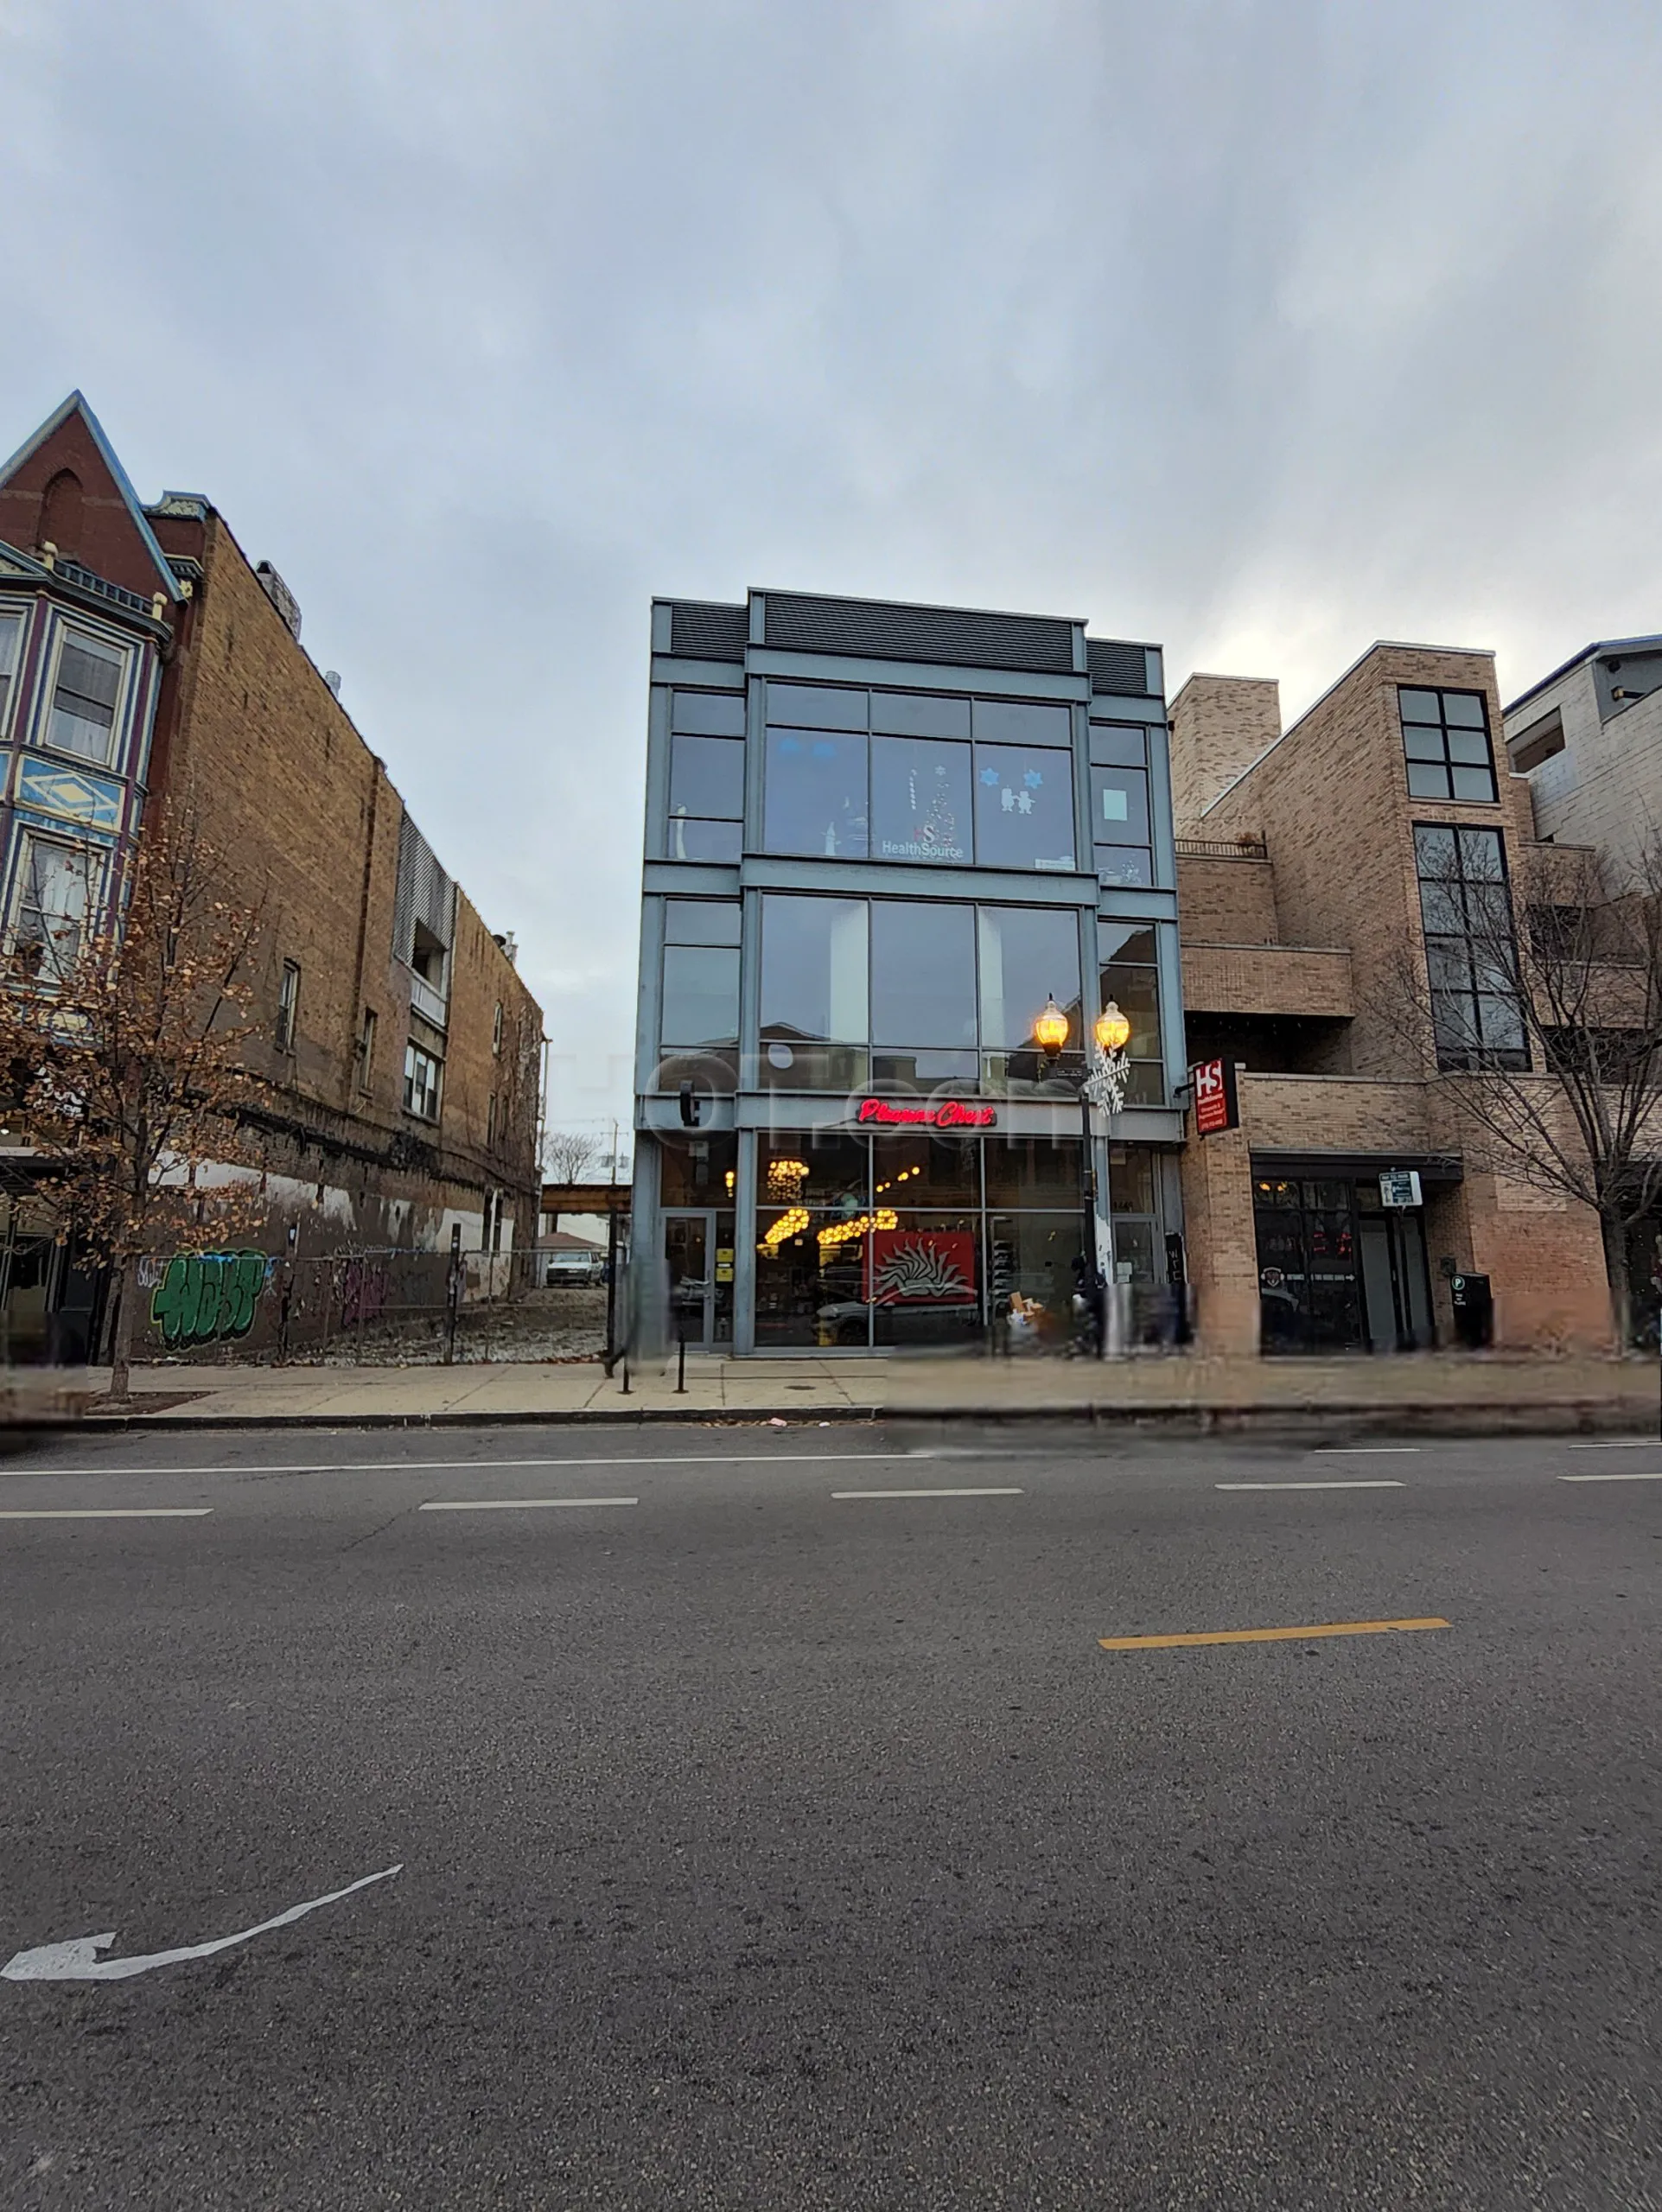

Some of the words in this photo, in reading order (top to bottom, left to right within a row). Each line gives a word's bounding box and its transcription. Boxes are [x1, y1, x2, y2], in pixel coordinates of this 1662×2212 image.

[882, 840, 965, 860] HealthSource
[1195, 1059, 1223, 1098] HS
[936, 1101, 995, 1127] Chest
